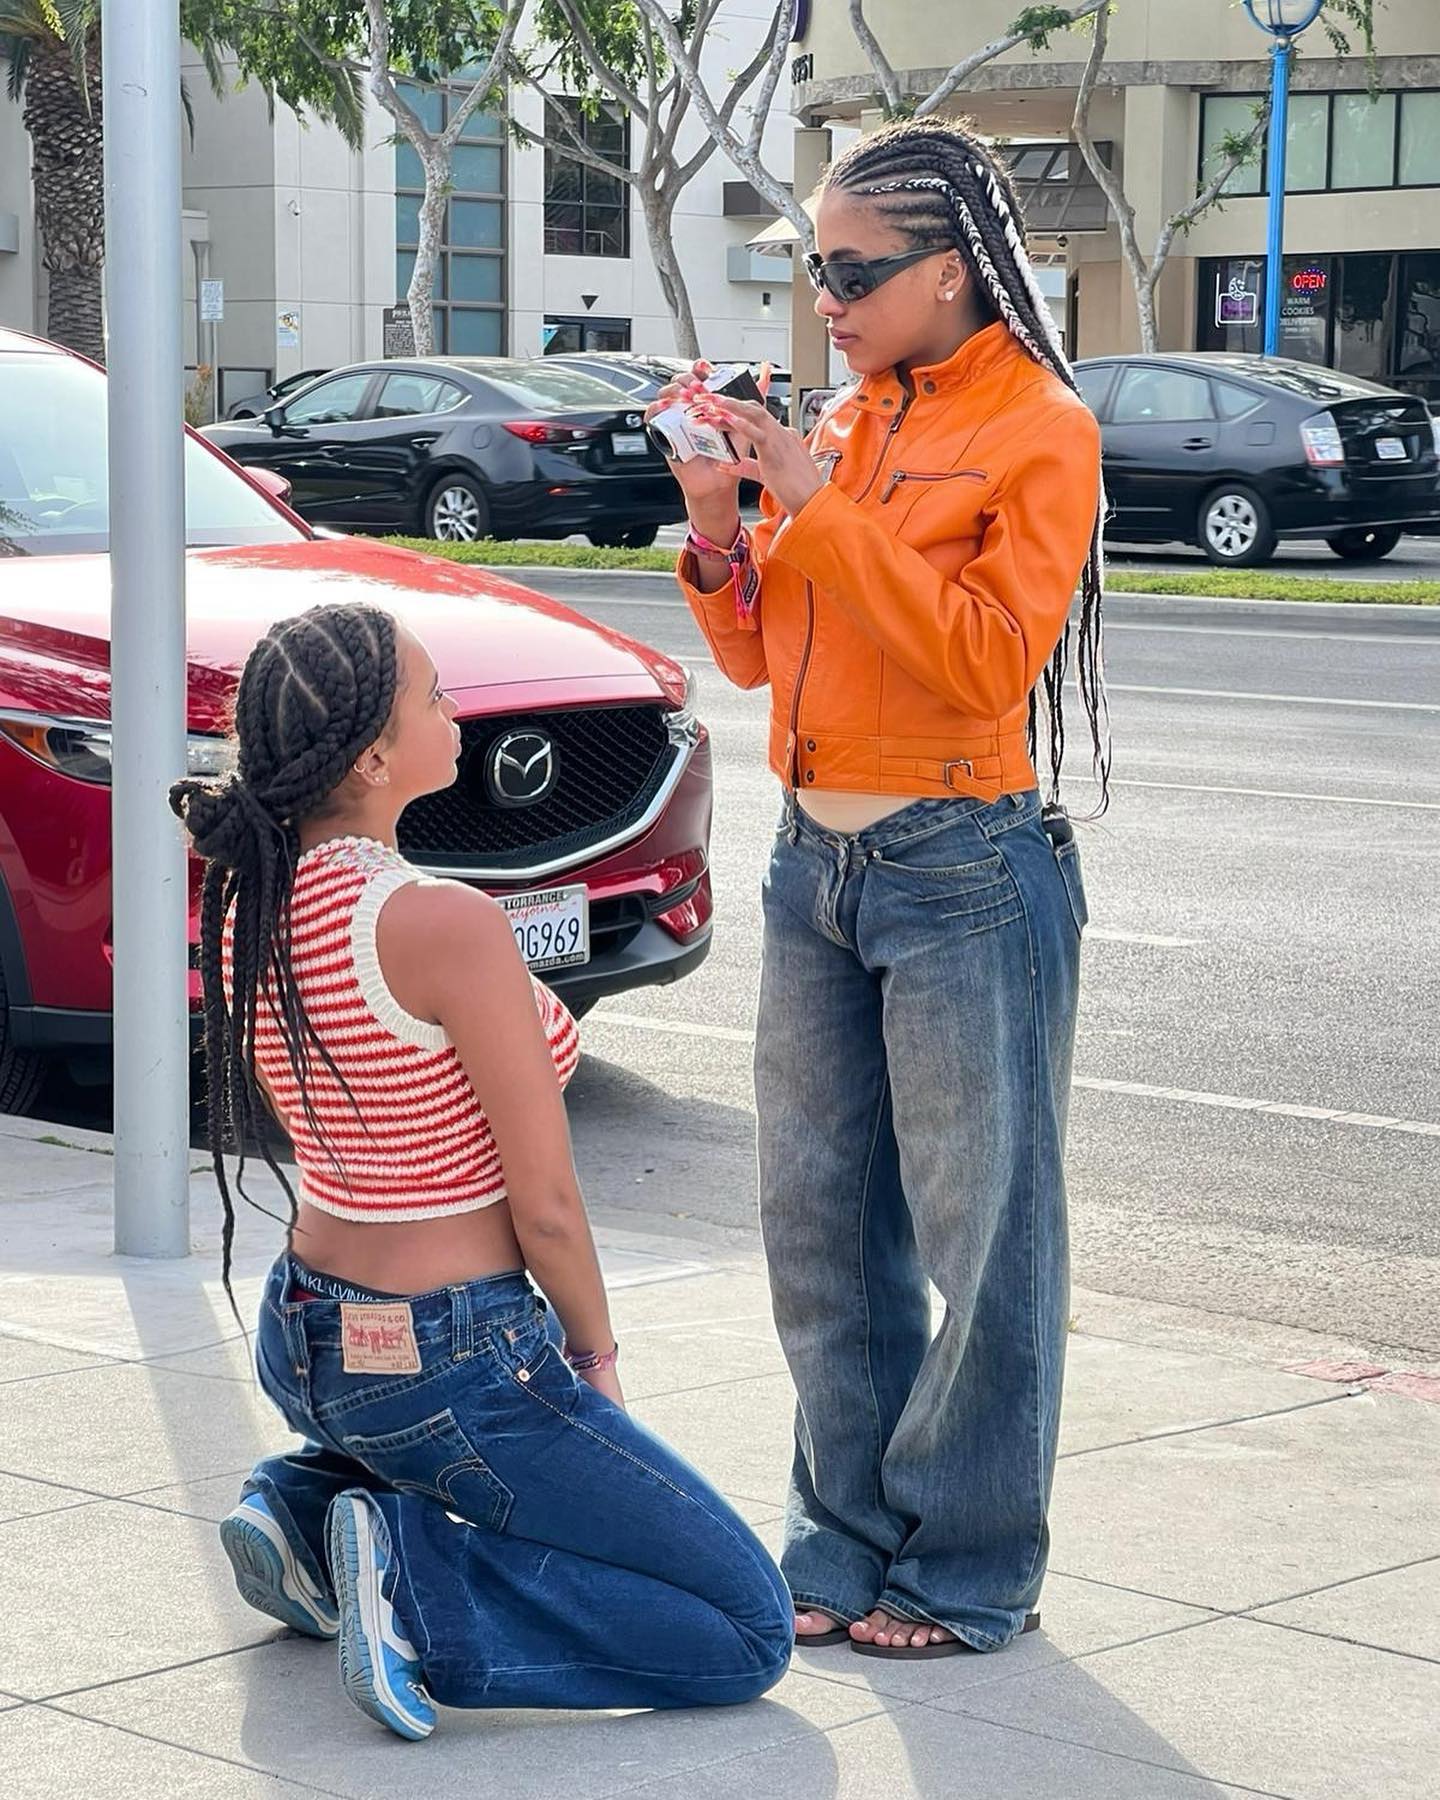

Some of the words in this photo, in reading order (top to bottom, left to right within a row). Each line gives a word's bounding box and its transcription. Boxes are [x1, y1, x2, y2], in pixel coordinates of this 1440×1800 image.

[1293, 274, 1326, 289] OPEN
[1286, 297, 1310, 305] WARM
[1282, 306, 1314, 316] COOKIES
[505, 891, 562, 909] TORRANCE
[508, 902, 566, 924] alifornia
